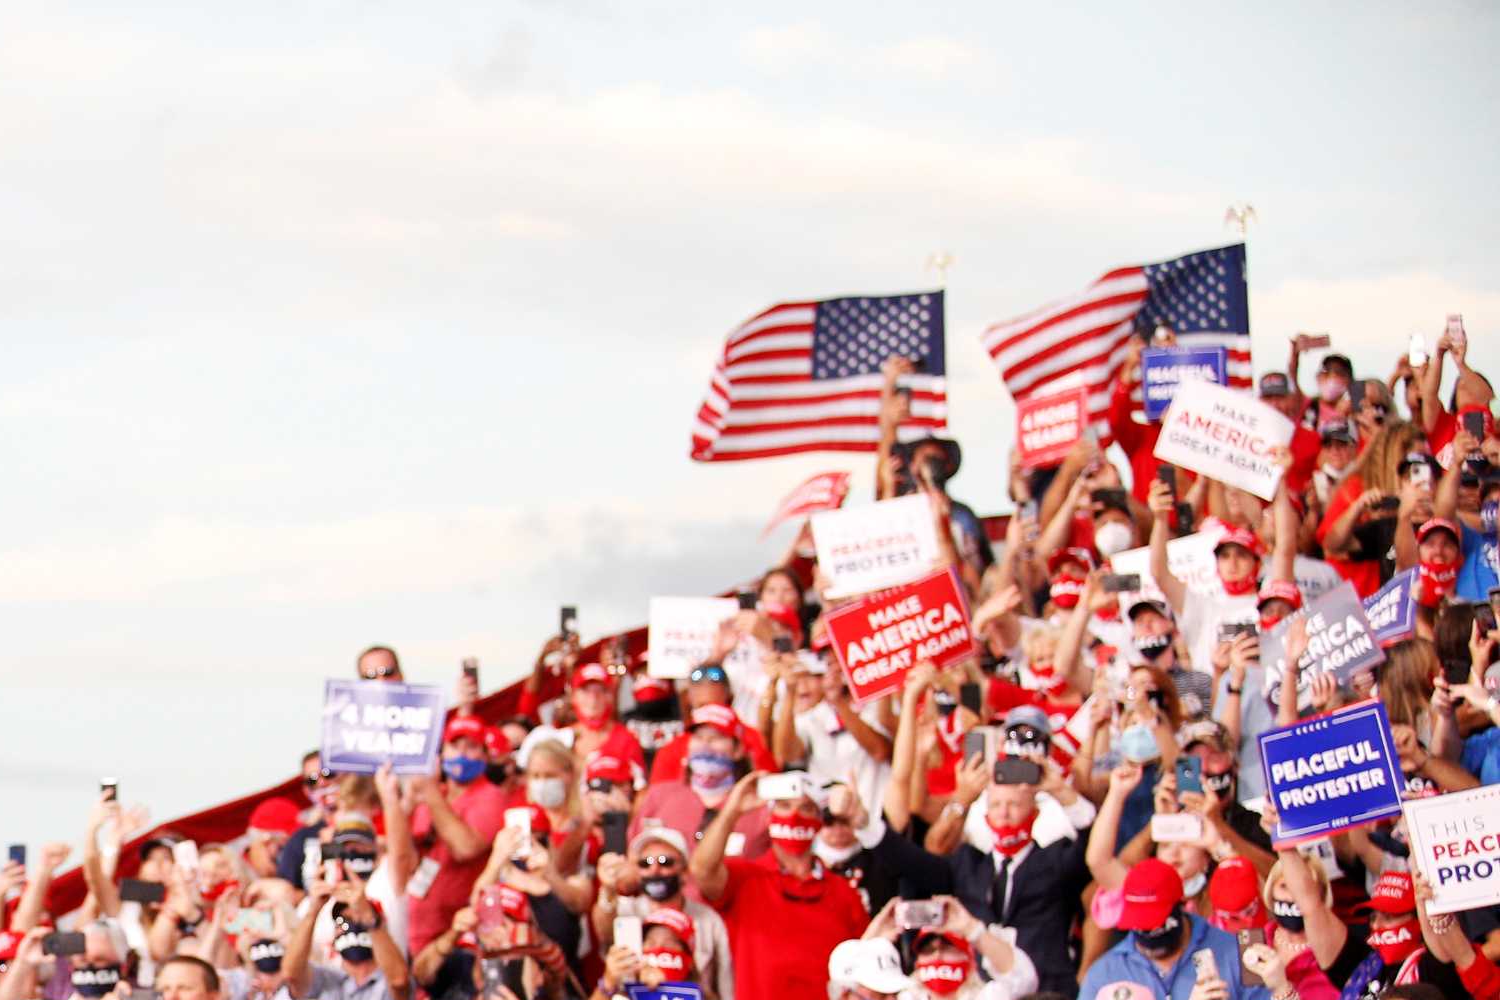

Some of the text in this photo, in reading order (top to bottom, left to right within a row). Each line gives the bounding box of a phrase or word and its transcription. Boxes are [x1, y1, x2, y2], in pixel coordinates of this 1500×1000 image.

[1212, 402, 1259, 428] MAKE
[1169, 432, 1274, 481] GREAT AGAIN
[835, 548, 920, 574] PROTEST
[868, 595, 923, 630] MAKE
[847, 602, 963, 667] AMERICA
[852, 626, 968, 686] GREAT AGAIN
[1271, 740, 1381, 784] PEACEFUL
[1279, 768, 1386, 810] PROTESTER
[1429, 816, 1485, 839] THIS
[334, 932, 372, 951] MAG
[71, 969, 119, 985] MAGA
